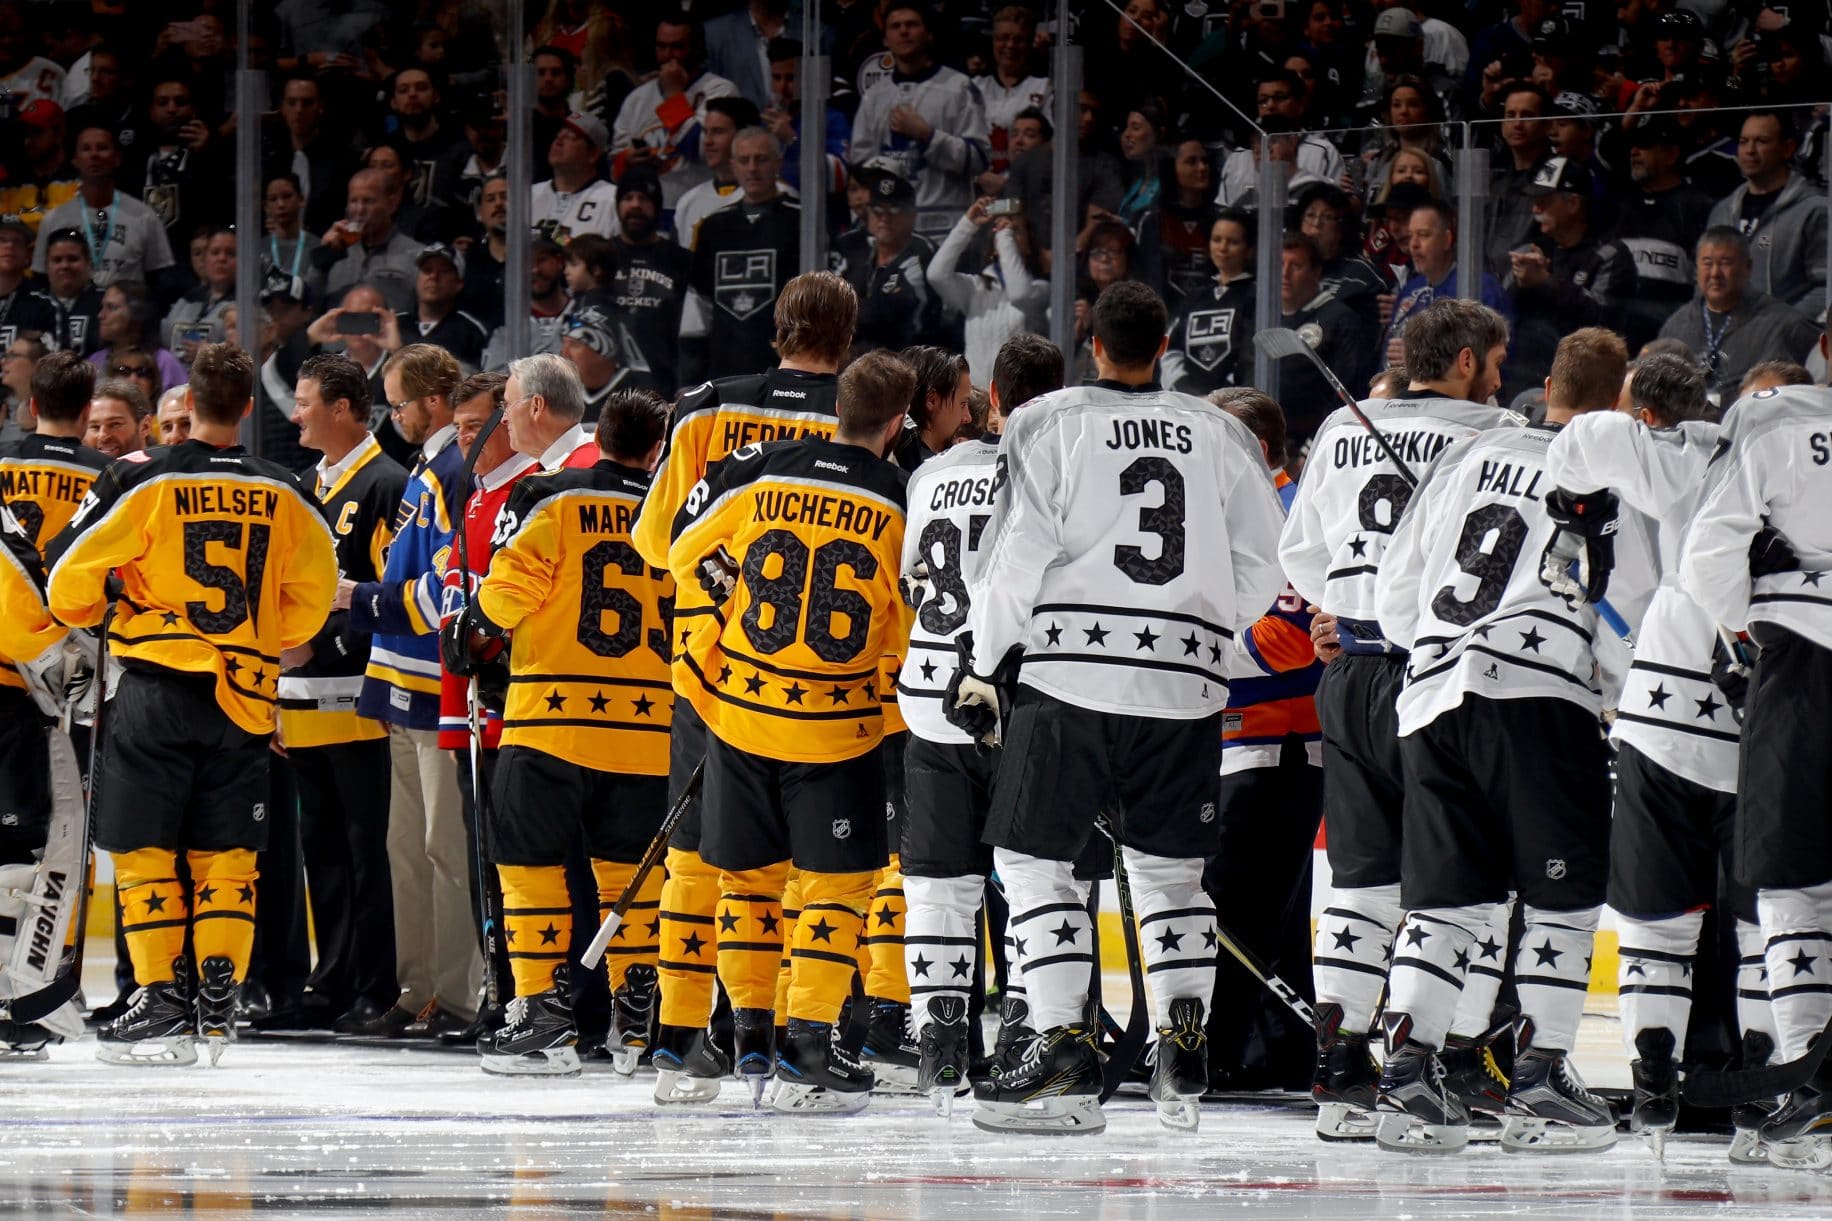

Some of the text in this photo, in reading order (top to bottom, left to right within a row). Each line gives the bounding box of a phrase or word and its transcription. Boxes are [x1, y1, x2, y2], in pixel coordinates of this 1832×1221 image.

[577, 202, 596, 222] C
[629, 267, 673, 290] KINGS
[720, 255, 770, 279] LA
[1190, 315, 1229, 337] LA
[772, 389, 807, 400] Reebok
[1106, 419, 1193, 454] JONES
[814, 459, 849, 474] Reebok
[1476, 460, 1543, 501] HALL
[174, 486, 278, 520] NIELSEN
[335, 500, 359, 536] C
[416, 491, 430, 528] C
[1113, 456, 1186, 586] 3
[183, 519, 271, 639] 51
[432, 545, 453, 580] 4
[1430, 503, 1530, 628] 9
[740, 528, 879, 664] 86
[26, 870, 67, 973] VAUGHN
